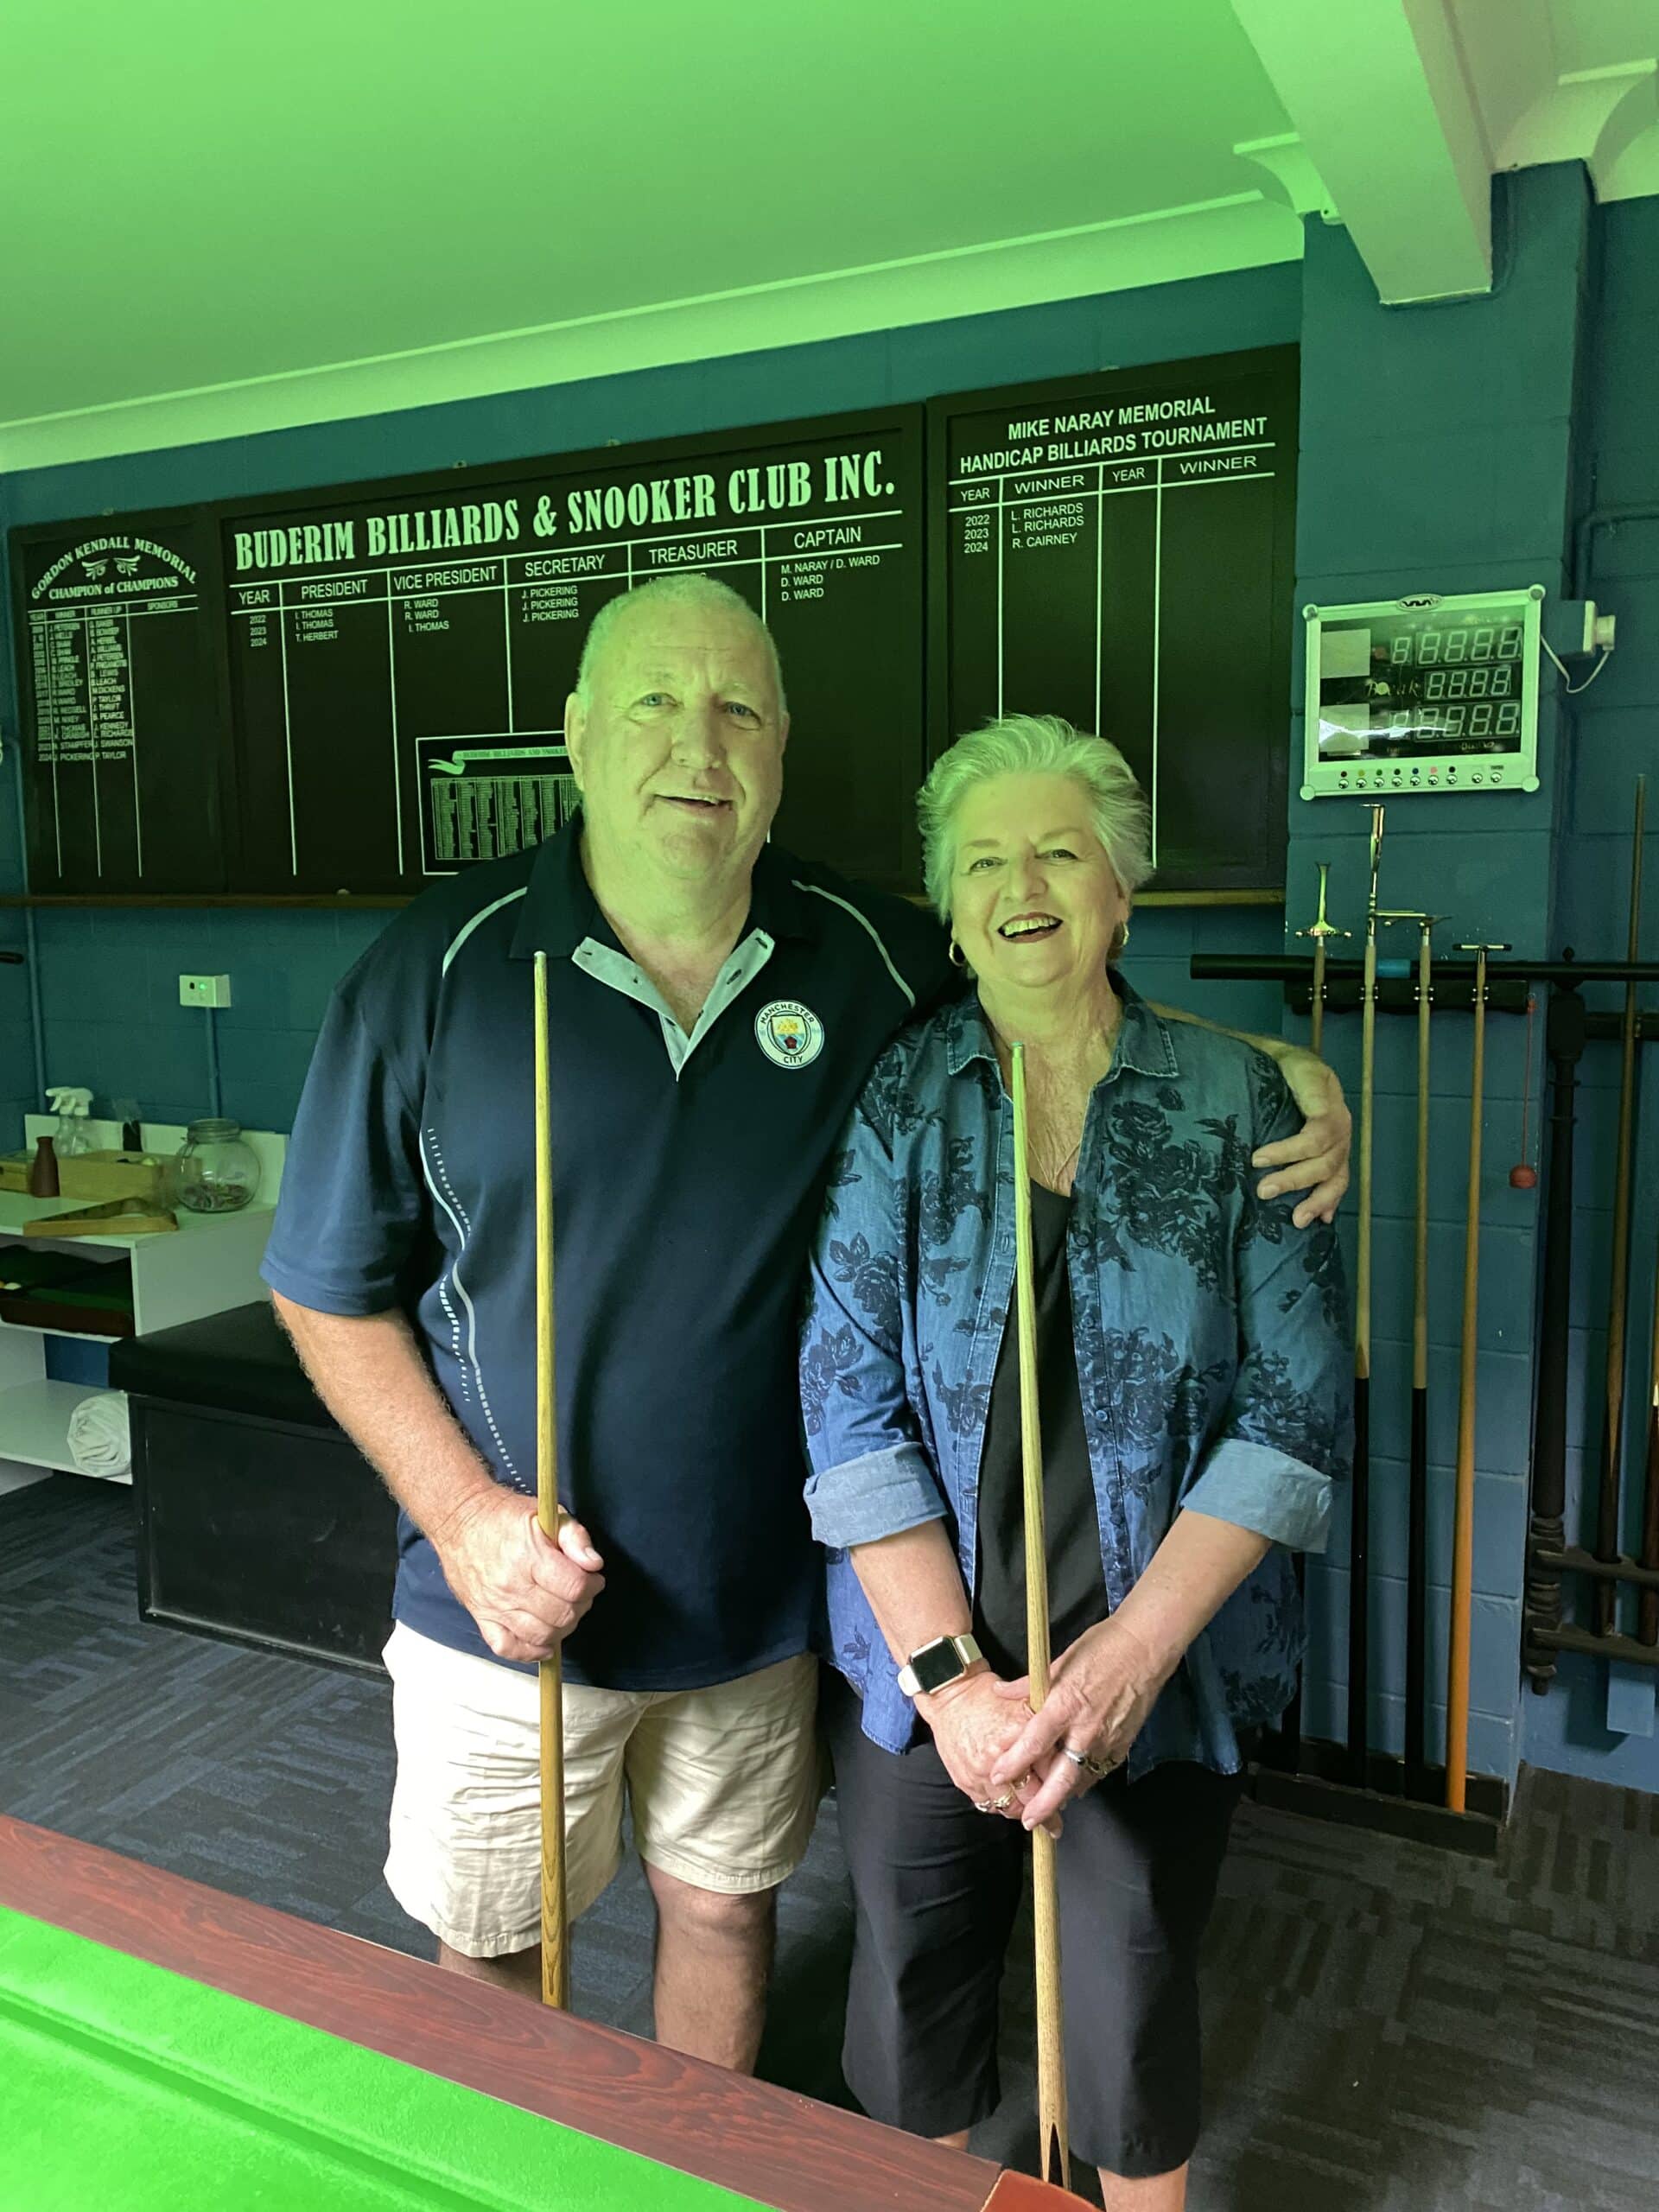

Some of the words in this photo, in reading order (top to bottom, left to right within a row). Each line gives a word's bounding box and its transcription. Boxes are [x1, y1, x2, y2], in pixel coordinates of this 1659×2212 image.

[1008, 418, 1050, 441] MIKE
[1054, 410, 1114, 434] NARAY
[1118, 396, 1216, 426] MEMORIAL
[960, 447, 1043, 474] HANDICAP
[1047, 433, 1136, 461] BILLIARDS
[1141, 416, 1268, 448] TOURNAMENT
[1179, 455, 1258, 475] WINNER
[1112, 467, 1146, 483] YEAR
[1014, 474, 1085, 494] WINNER
[960, 487, 990, 502] YEAR
[234, 520, 355, 570] BUDERIM
[367, 499, 520, 556] BILLIARDS
[533, 495, 557, 537] &
[568, 474, 716, 534] SNOOKER
[728, 461, 812, 514] CLUB
[823, 450, 895, 502] INC.
[1011, 510, 1020, 521] L.
[1023, 503, 1084, 519] RICHARDS
[965, 514, 990, 527] 2022
[1012, 524, 1021, 534] L.
[1024, 515, 1085, 533] RICHARDS
[793, 525, 862, 550] CAPTAIN
[964, 528, 989, 540] 2023
[1012, 537, 1024, 549] R.
[1027, 532, 1078, 548] CAIRNEY
[648, 540, 739, 564] TREASURER
[963, 541, 989, 554] 2024
[31, 551, 74, 600] GORDON
[74, 537, 130, 560] KENDALL
[134, 537, 197, 584] MEMORIAL
[524, 554, 606, 577] SECRETARY
[780, 564, 792, 575] M.
[794, 559, 829, 574] NARAY
[836, 559, 847, 569] D.
[849, 554, 881, 568] WARD
[393, 574, 423, 591] VICE
[425, 565, 498, 588] PRESIDENT
[780, 577, 791, 588] D.
[793, 575, 824, 587] WARD
[48, 583, 102, 601] CHAMPION
[105, 582, 115, 594] of
[116, 575, 179, 593] CHAMPIONS
[301, 579, 368, 600] PRESIDENT
[521, 589, 530, 600] J.
[530, 585, 578, 599] PICKERING
[781, 591, 791, 601] D.
[793, 588, 824, 600] WARD
[238, 589, 270, 605] YEAR
[414, 598, 439, 609] WARD
[522, 601, 530, 611] J.
[531, 596, 578, 610] PICKERING
[249, 614, 267, 625] 2022
[301, 608, 334, 619] THOMAS
[414, 609, 440, 620] WARD
[523, 613, 531, 623] J.
[531, 608, 580, 622] PICKERING
[302, 619, 334, 629] THOMAS
[415, 620, 450, 632] THOMAS
[302, 630, 340, 642] HERBERT
[760, 1002, 816, 1025] MANCHESTER
